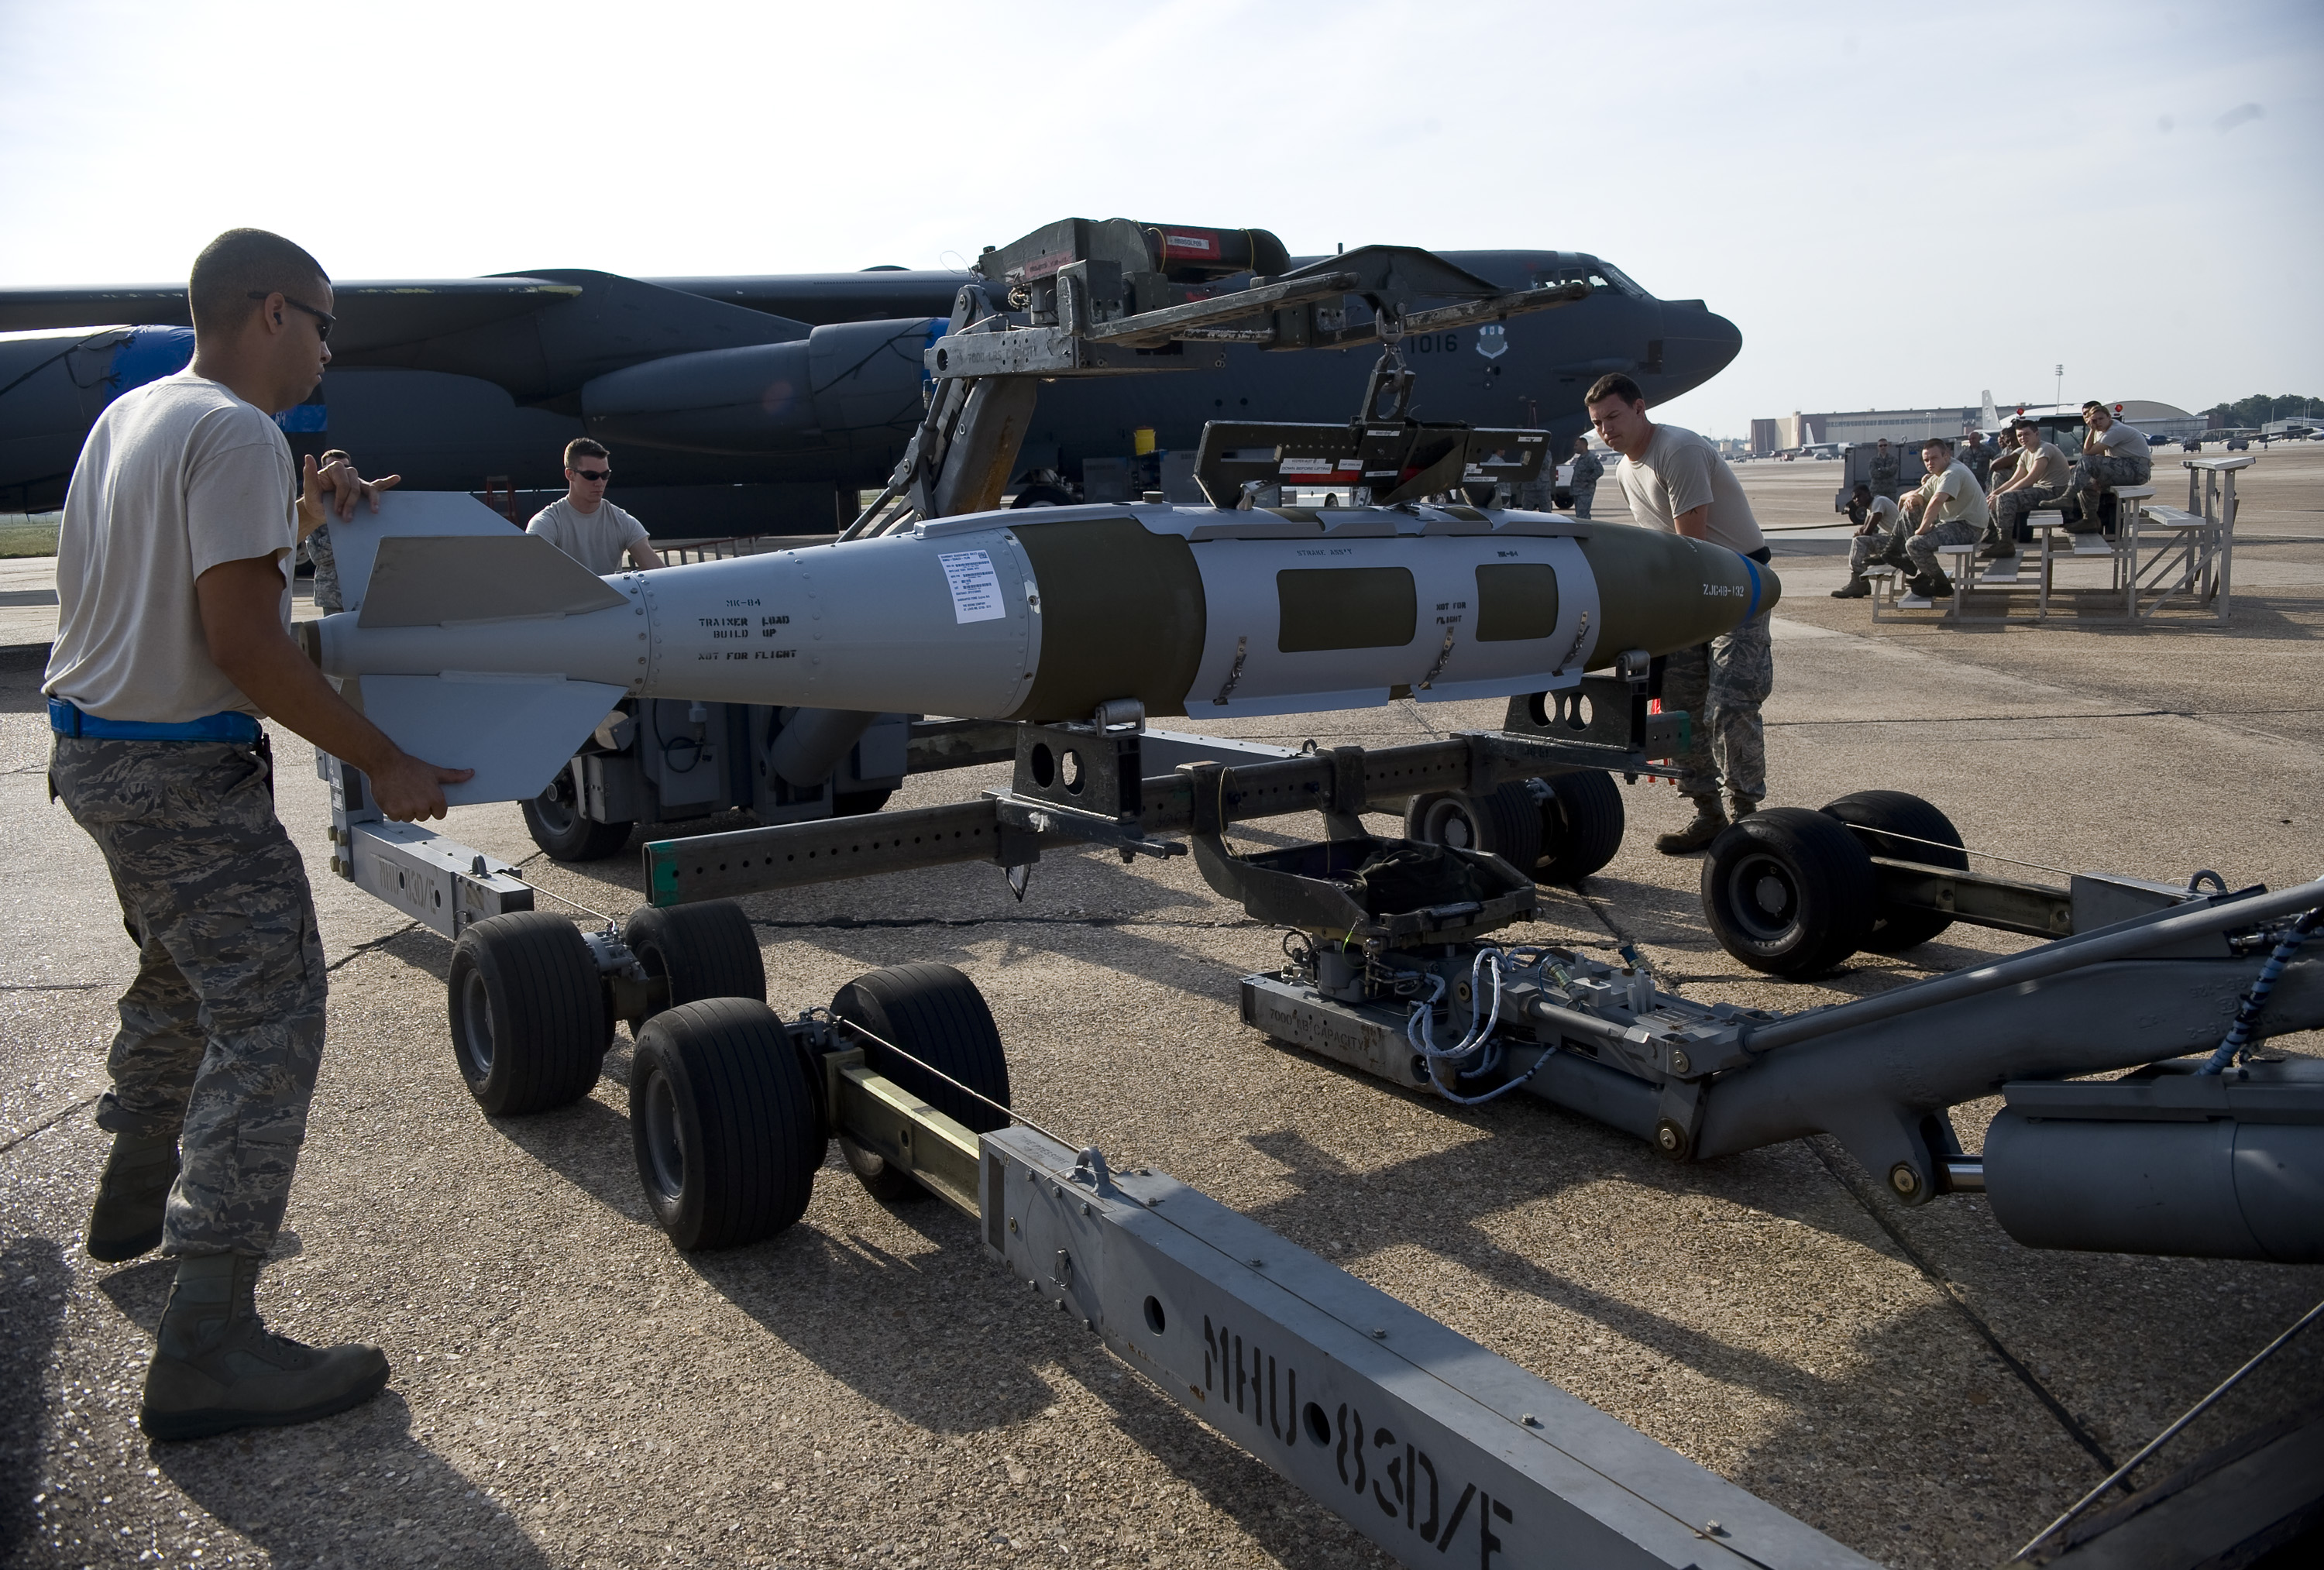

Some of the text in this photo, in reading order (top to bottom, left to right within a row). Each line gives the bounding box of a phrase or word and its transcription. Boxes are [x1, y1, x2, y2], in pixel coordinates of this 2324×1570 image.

[1411, 334, 1458, 354] 1016
[726, 598, 761, 607] MK-84
[1435, 601, 1466, 611] NOT FOR
[698, 616, 790, 627] TRAINER LOAD
[1435, 615, 1463, 624] FLIGHT
[713, 628, 777, 639] BUILD UP
[698, 649, 797, 661] NOT FOR FLIGHT
[1270, 1008, 1292, 1025] 7000
[1313, 1023, 1365, 1050] CAPACITY
[1032, 1144, 1070, 1165] PRESSURE
